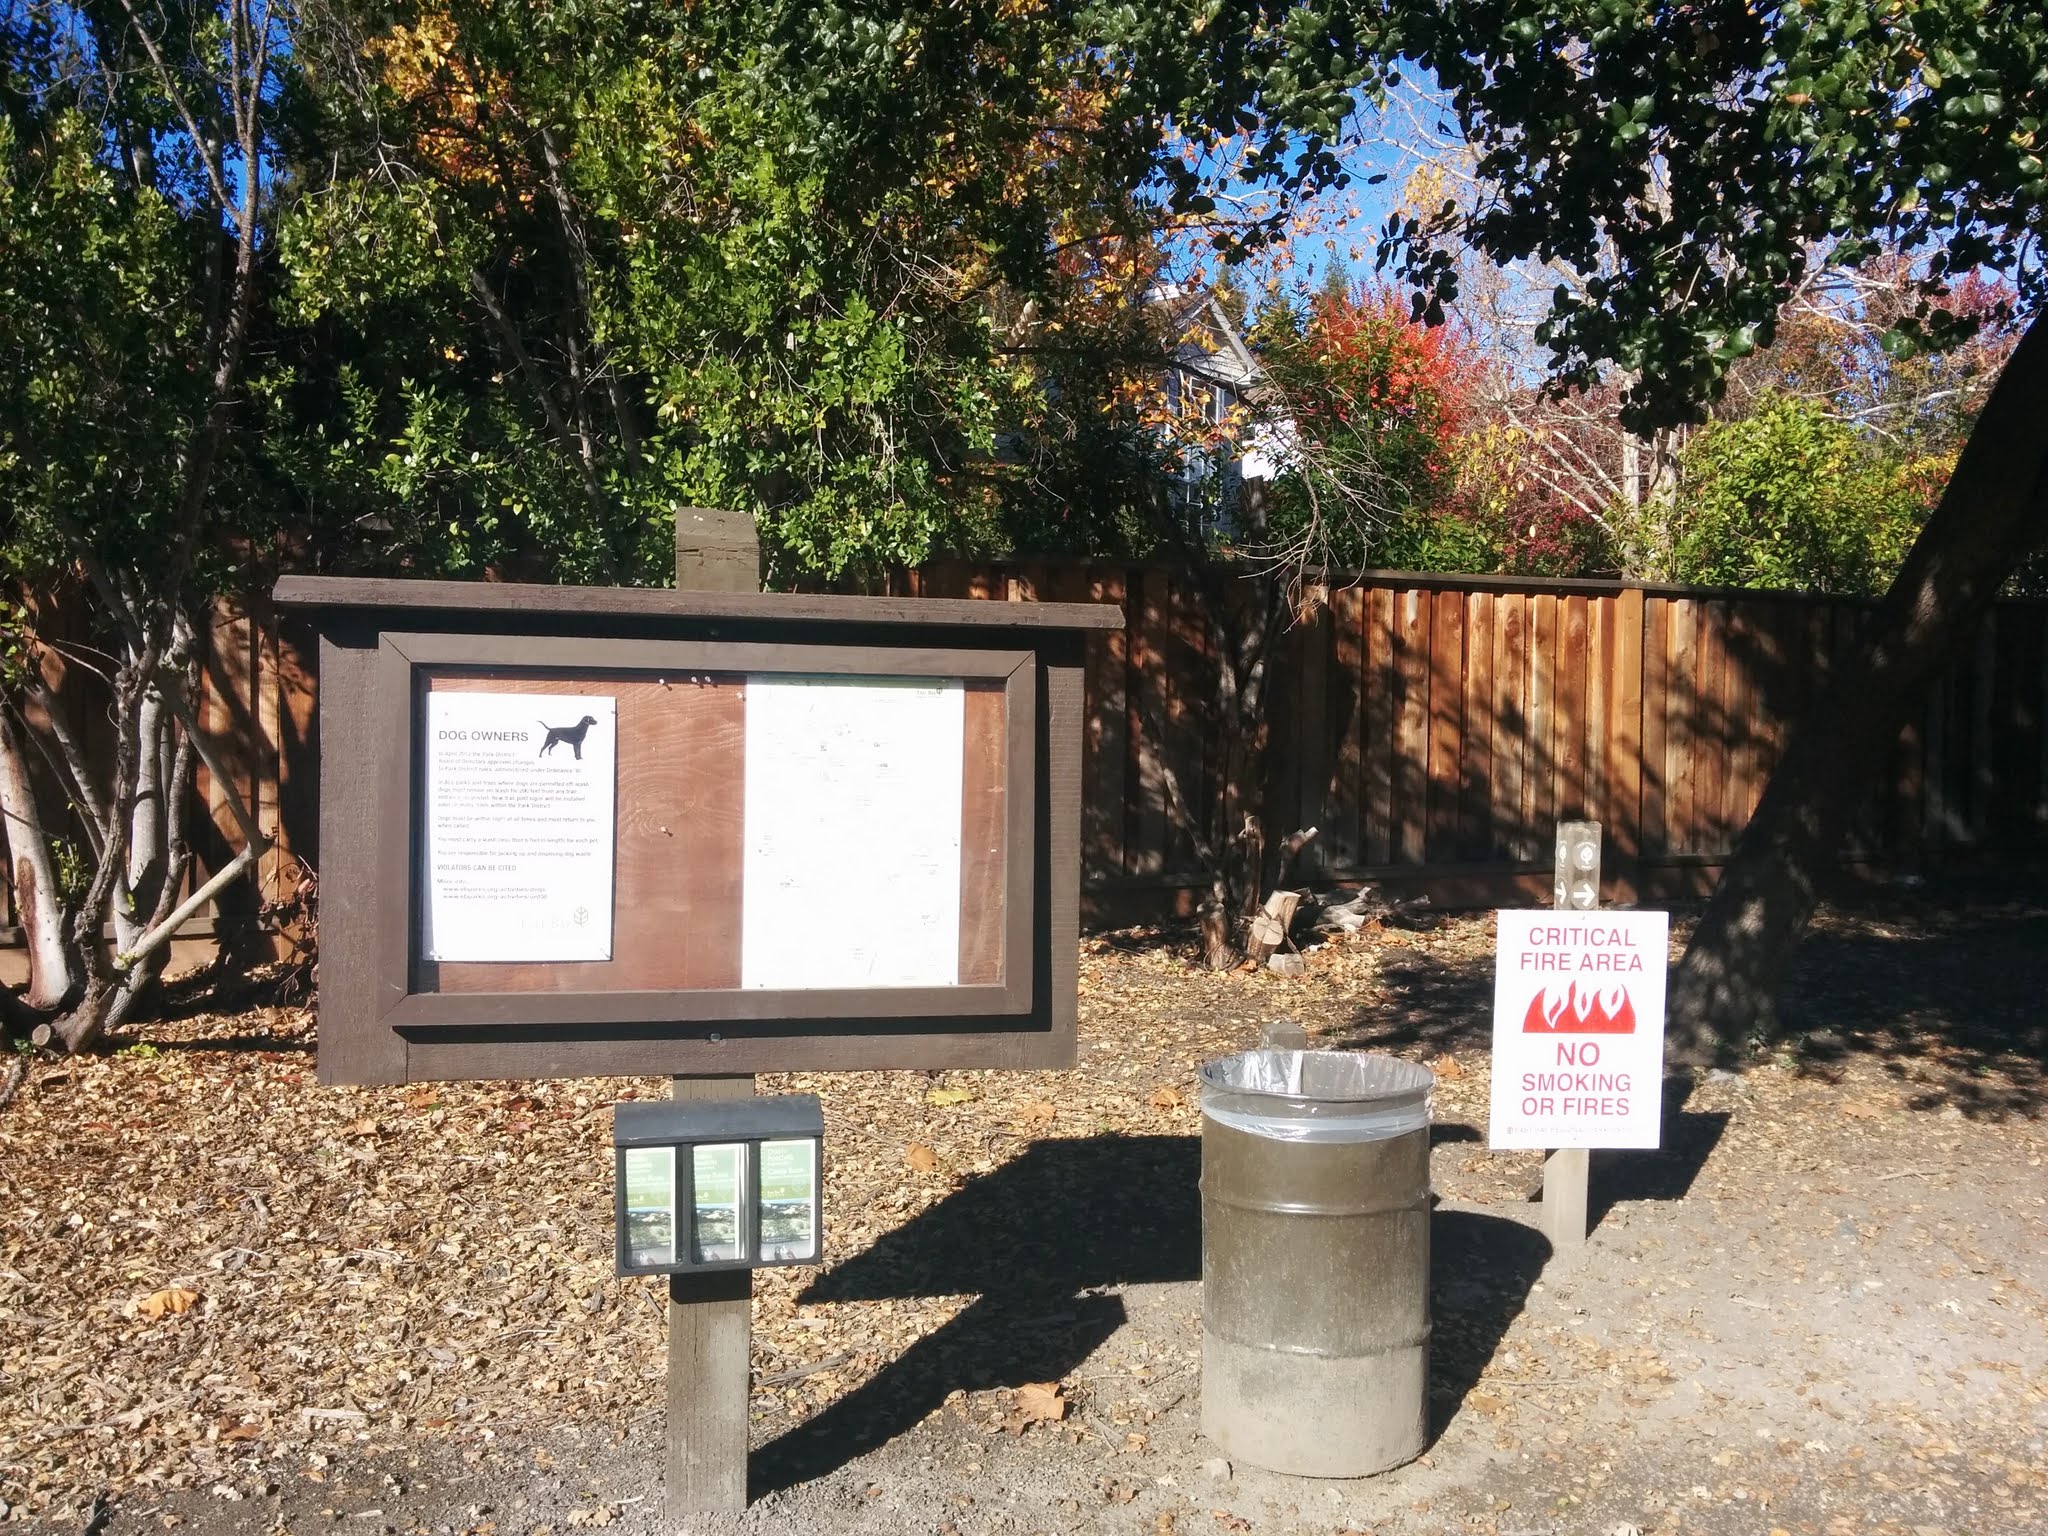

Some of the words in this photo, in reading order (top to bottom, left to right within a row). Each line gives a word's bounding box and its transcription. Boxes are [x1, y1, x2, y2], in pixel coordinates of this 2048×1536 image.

[439, 731, 467, 740] DOG
[471, 731, 528, 741] OWNERS
[1529, 927, 1637, 946] CRITICAL
[1520, 953, 1572, 971] FIRE
[1579, 953, 1643, 971] AREA
[1556, 1042, 1600, 1066] NO
[1522, 1073, 1631, 1092] SMOKING
[1522, 1098, 1554, 1116] OR
[1563, 1098, 1630, 1116] FIRES
